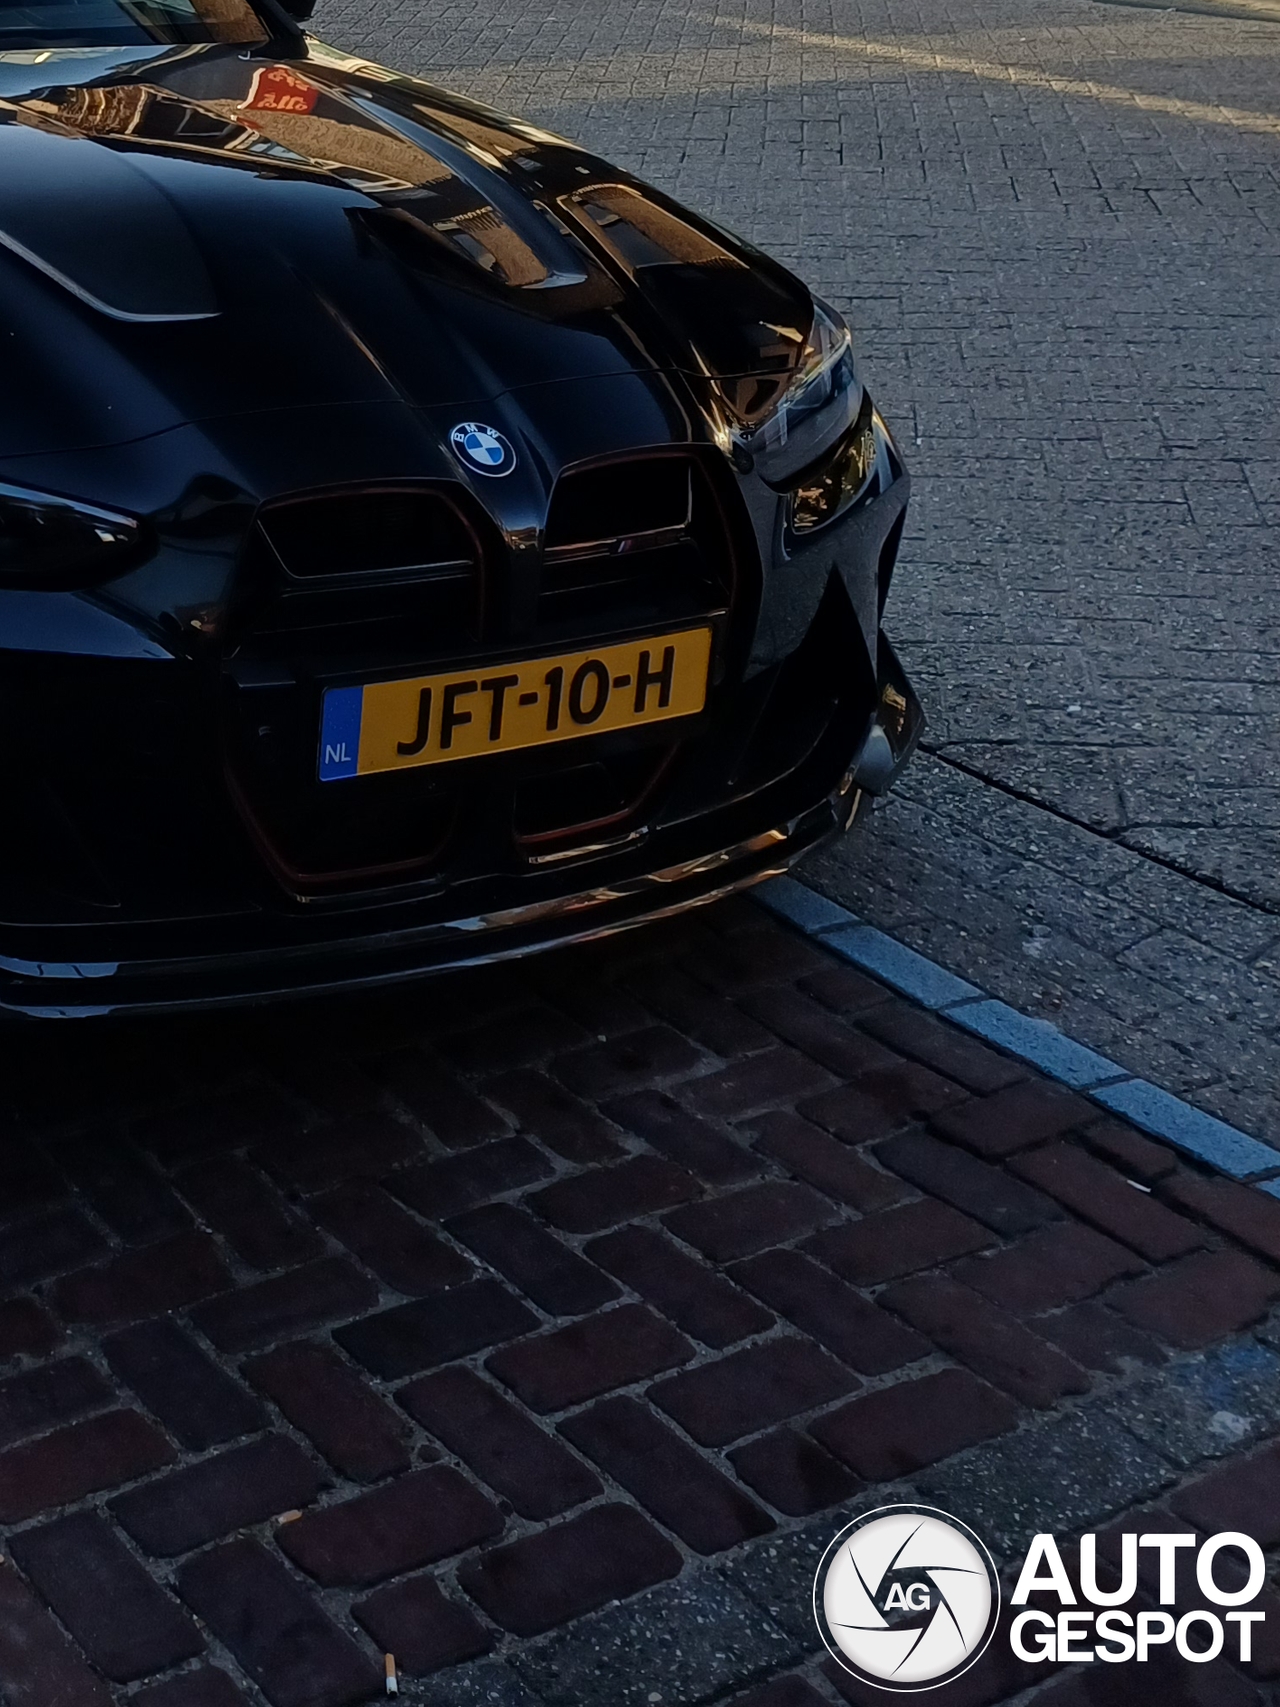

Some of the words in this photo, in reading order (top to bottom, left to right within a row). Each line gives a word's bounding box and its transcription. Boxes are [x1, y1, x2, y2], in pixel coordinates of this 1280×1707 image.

[454, 423, 500, 443] BMW
[396, 645, 675, 757] JFT-10-H
[325, 743, 351, 764] NL
